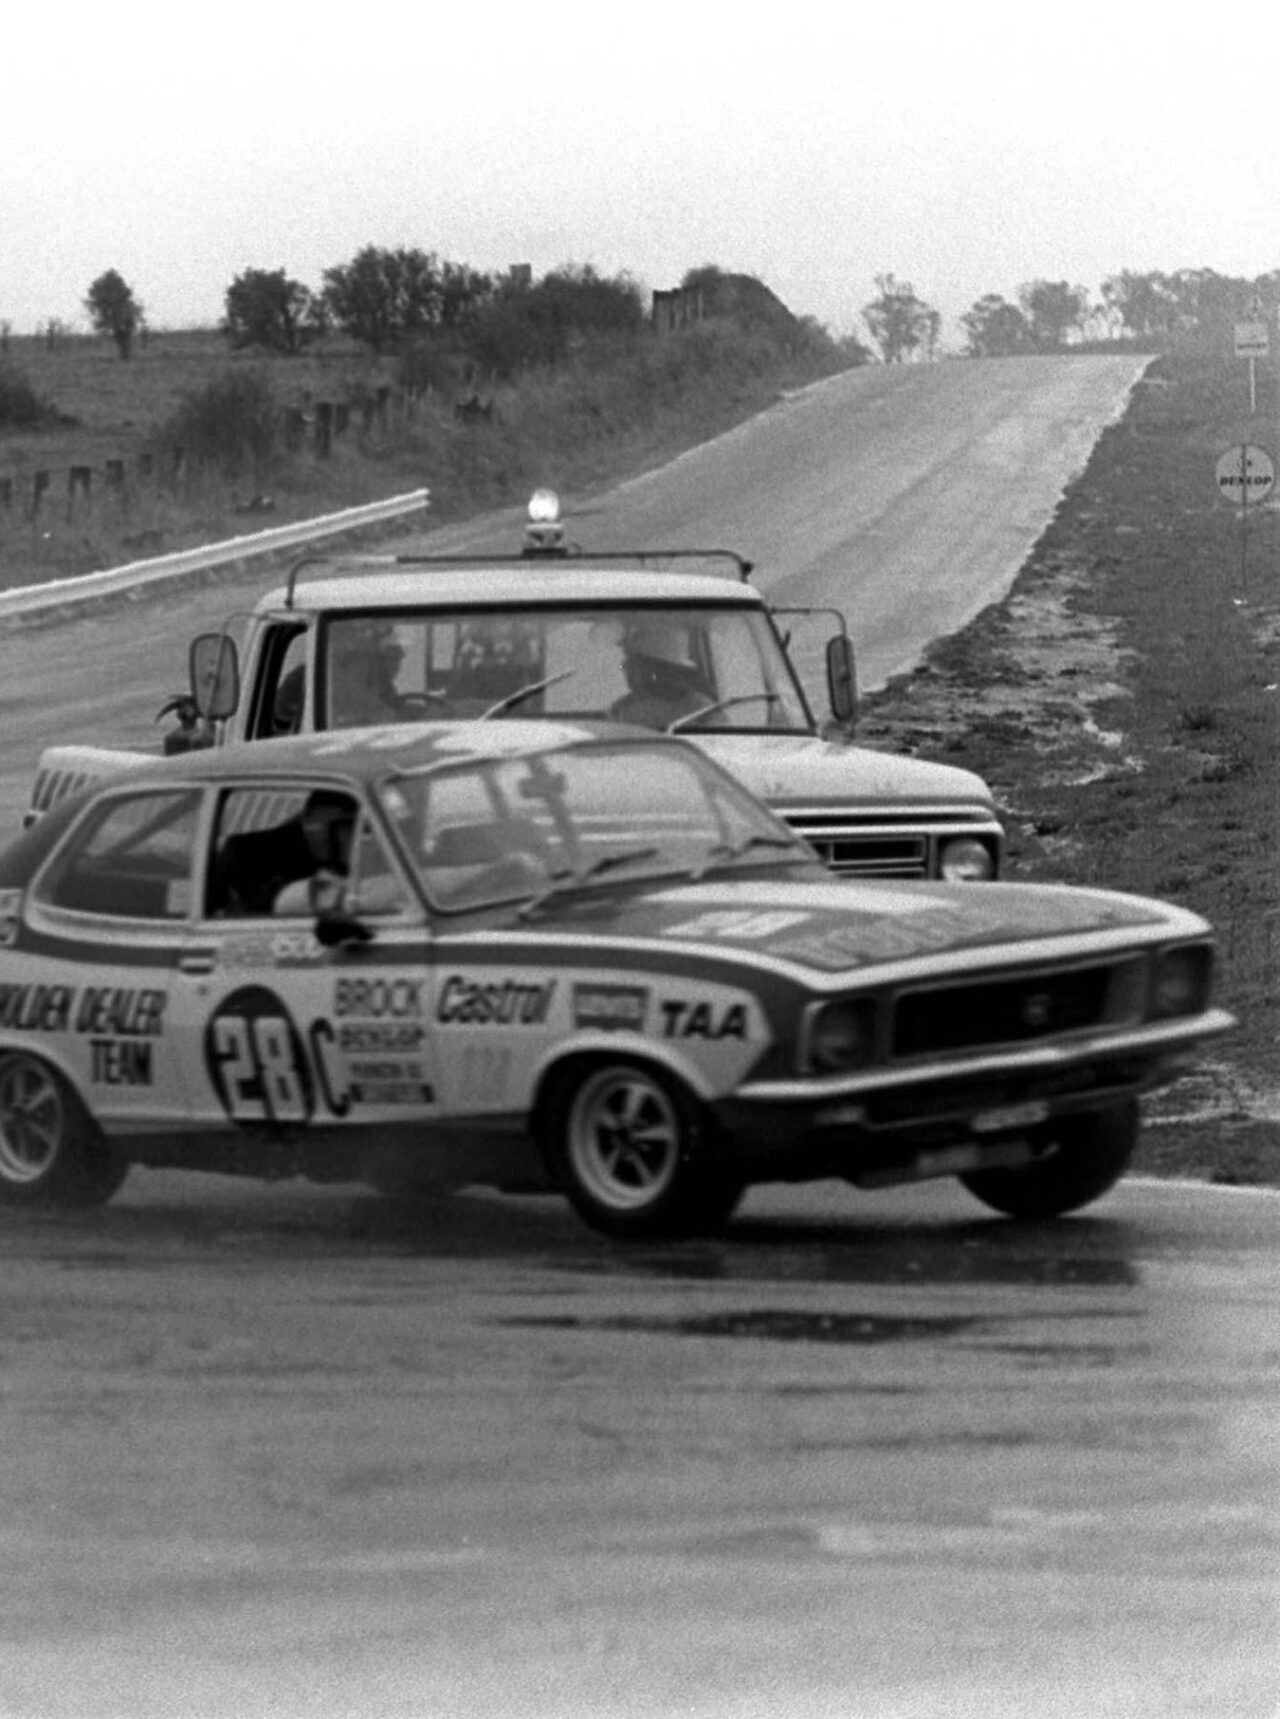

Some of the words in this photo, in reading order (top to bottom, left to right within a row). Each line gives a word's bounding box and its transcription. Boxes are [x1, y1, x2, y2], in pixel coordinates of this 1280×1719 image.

[76, 985, 168, 1037] DEALER
[437, 974, 558, 1024] Castrol
[660, 1000, 747, 1040] TAA
[89, 1039, 153, 1086] TEAM
